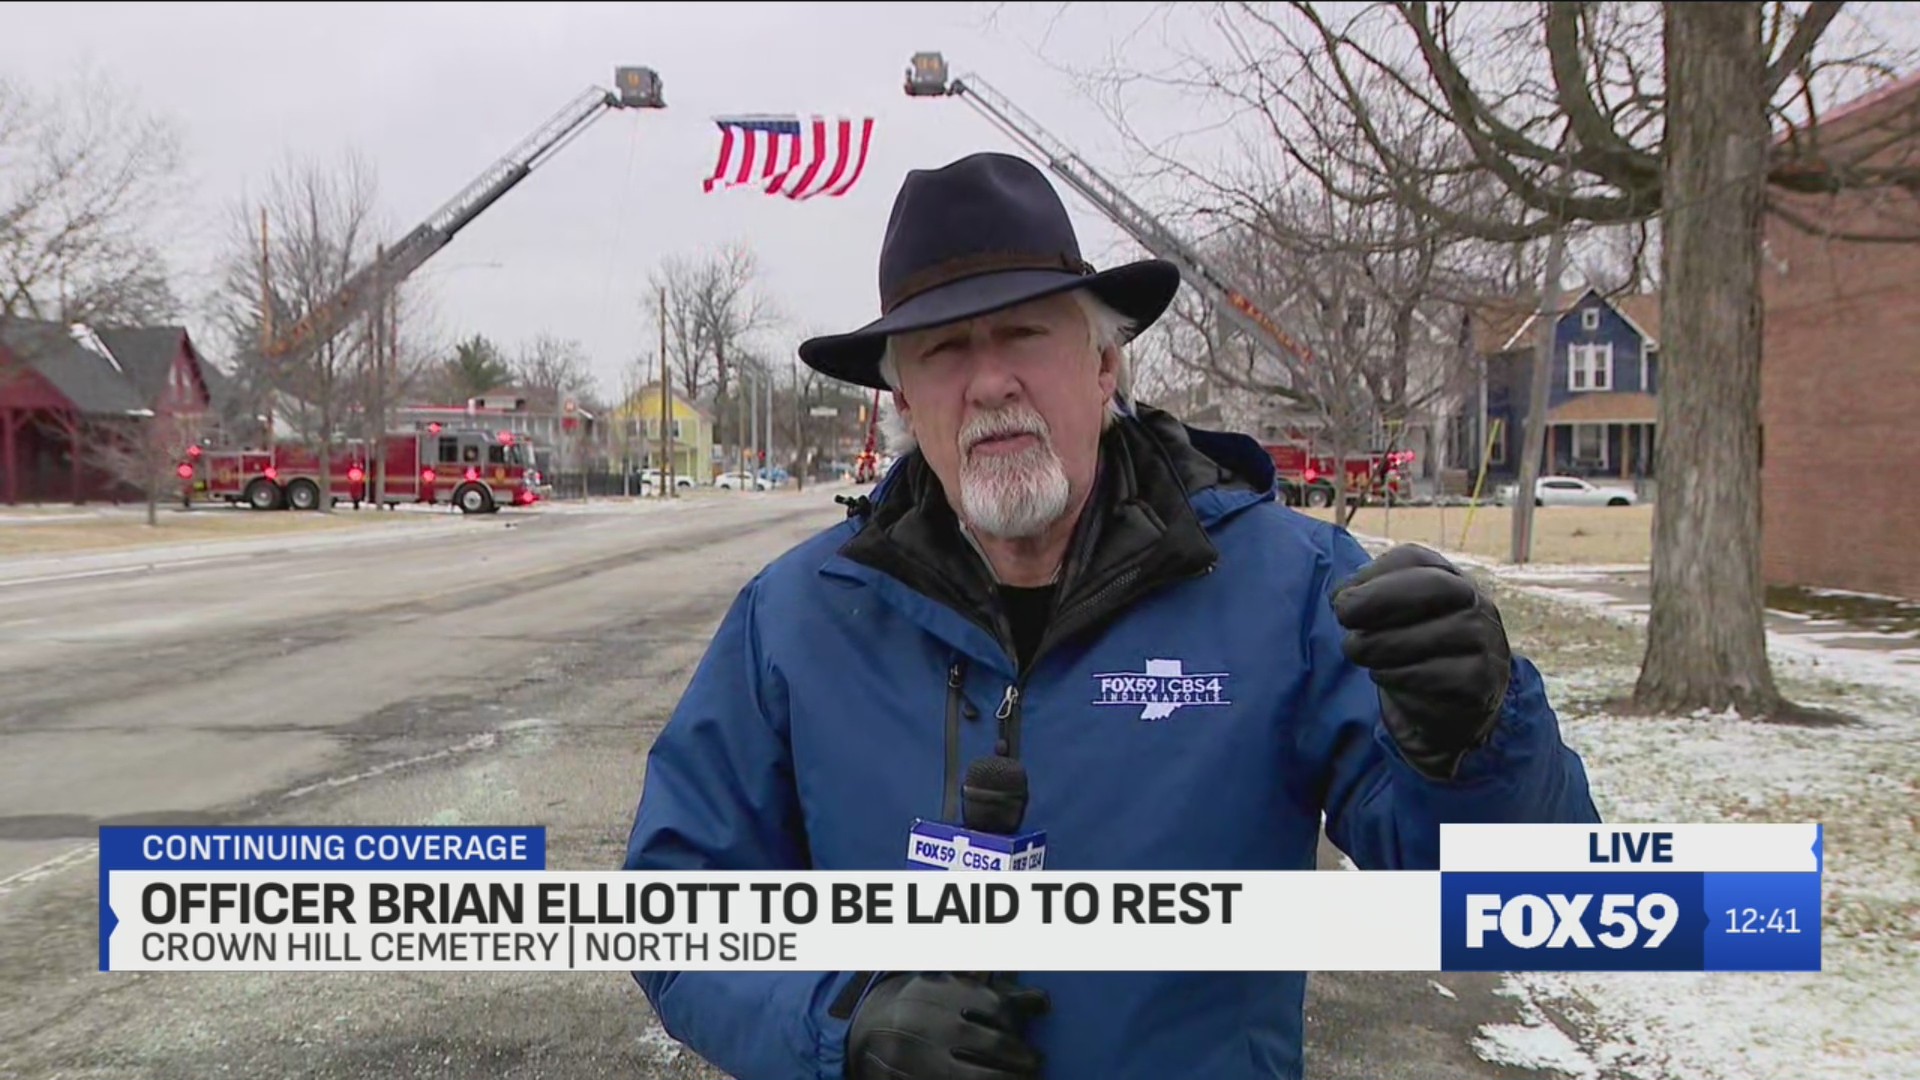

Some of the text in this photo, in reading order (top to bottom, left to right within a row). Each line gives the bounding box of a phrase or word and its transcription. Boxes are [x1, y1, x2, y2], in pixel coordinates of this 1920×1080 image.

[1101, 678, 1222, 693] FOX59 CBS4
[1102, 692, 1220, 702] INDIANAPOLIS
[915, 841, 956, 863] FOX59
[962, 851, 1001, 870] CBS4
